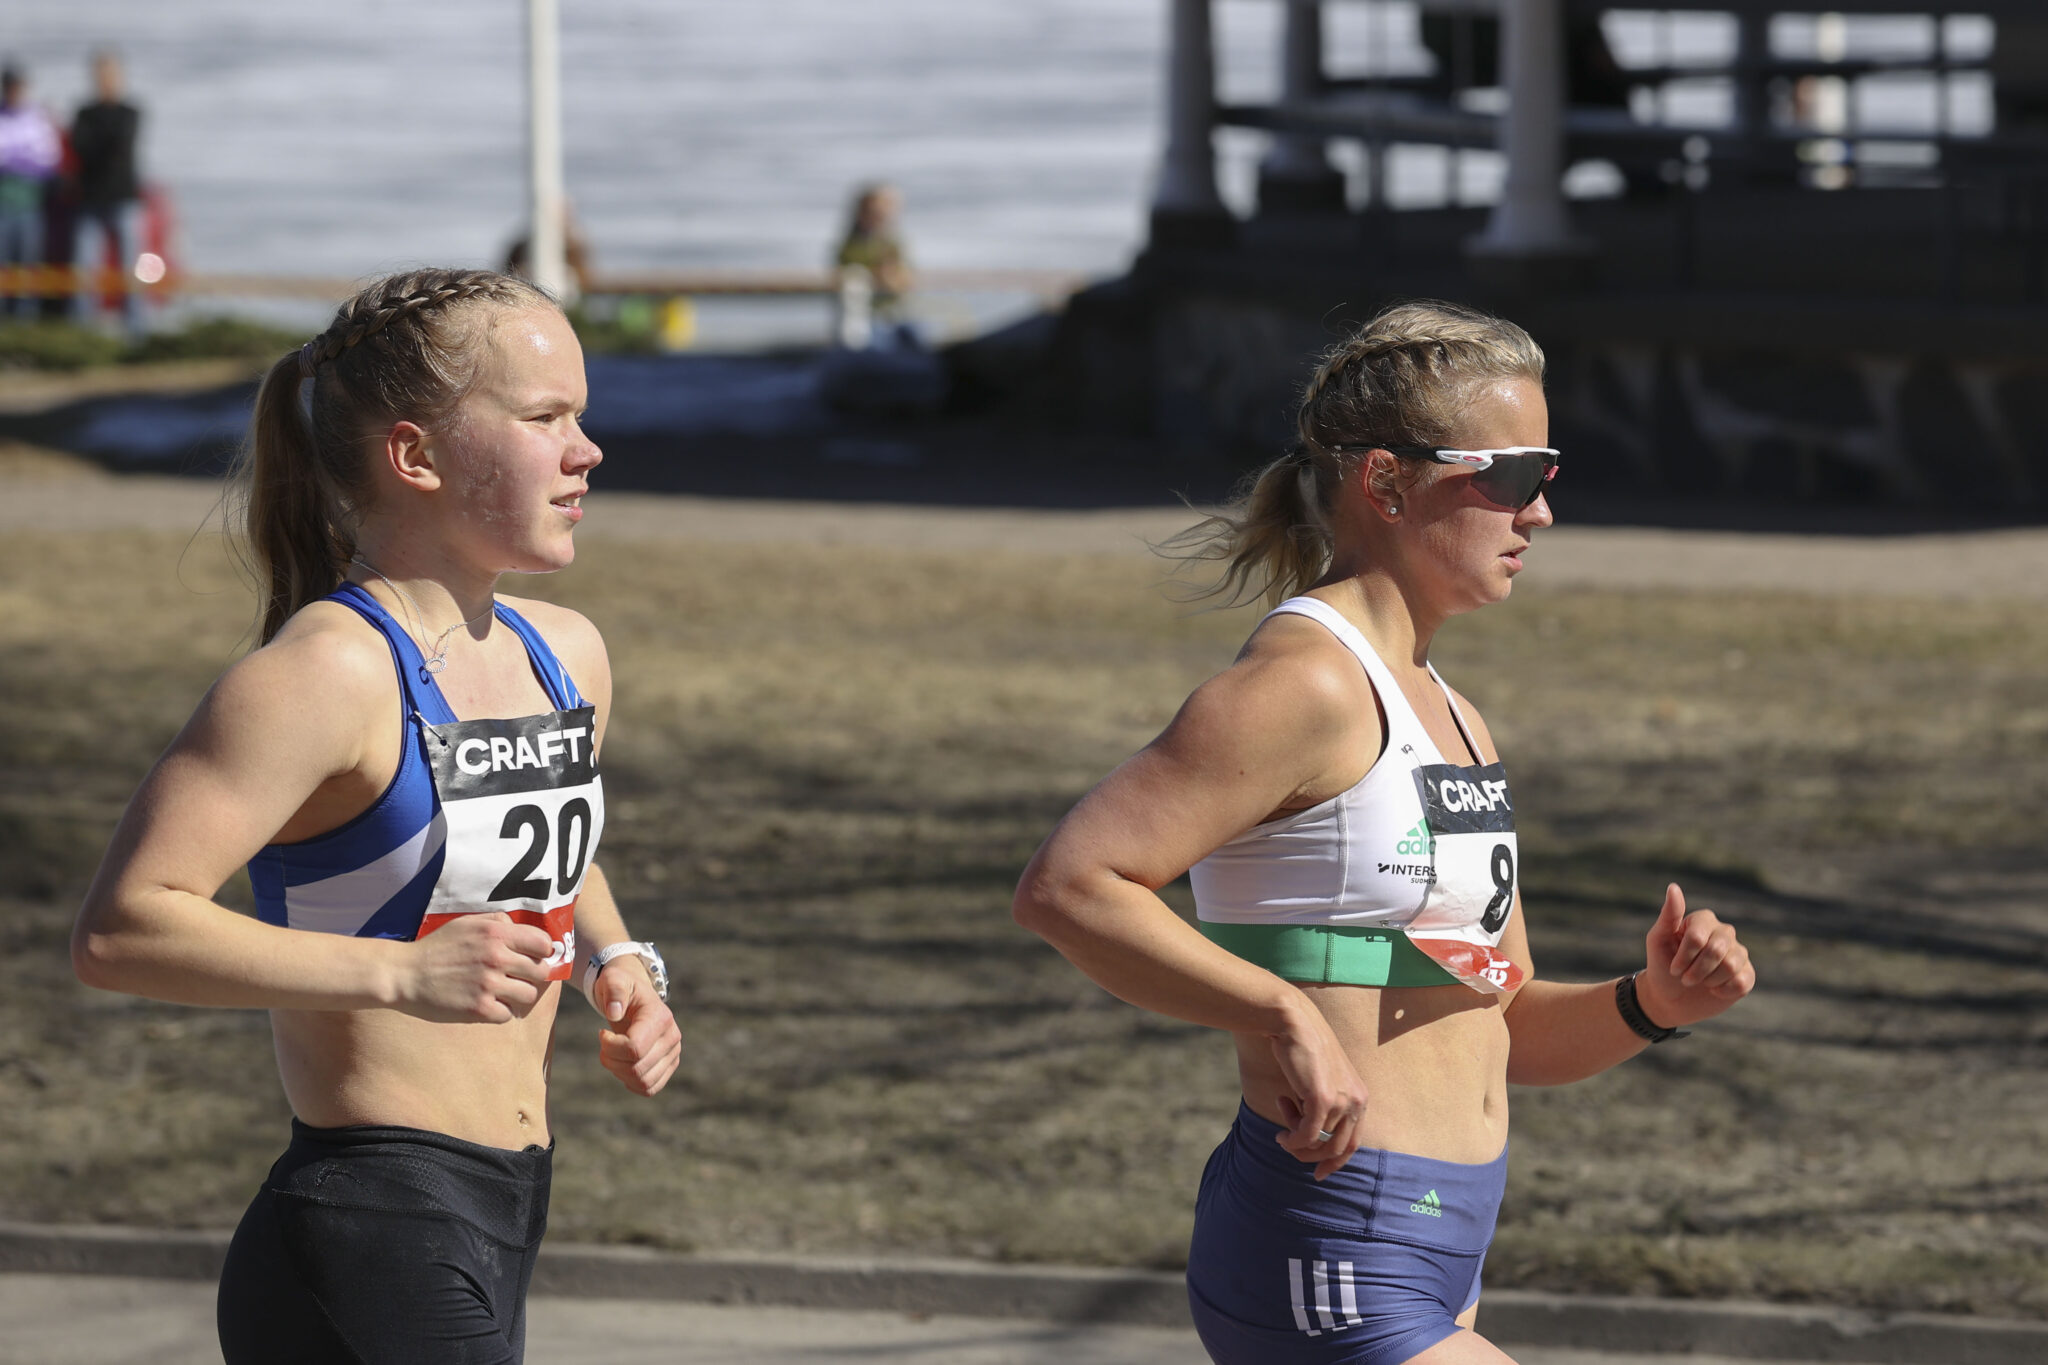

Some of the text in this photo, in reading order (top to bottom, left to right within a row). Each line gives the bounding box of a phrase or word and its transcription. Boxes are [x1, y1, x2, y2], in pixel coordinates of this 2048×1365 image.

[455, 726, 587, 776] CRAFT
[1439, 779, 1511, 813] CRAFT
[486, 796, 592, 902] 20
[1480, 843, 1514, 934] 8
[1410, 1203, 1442, 1218] adidas
